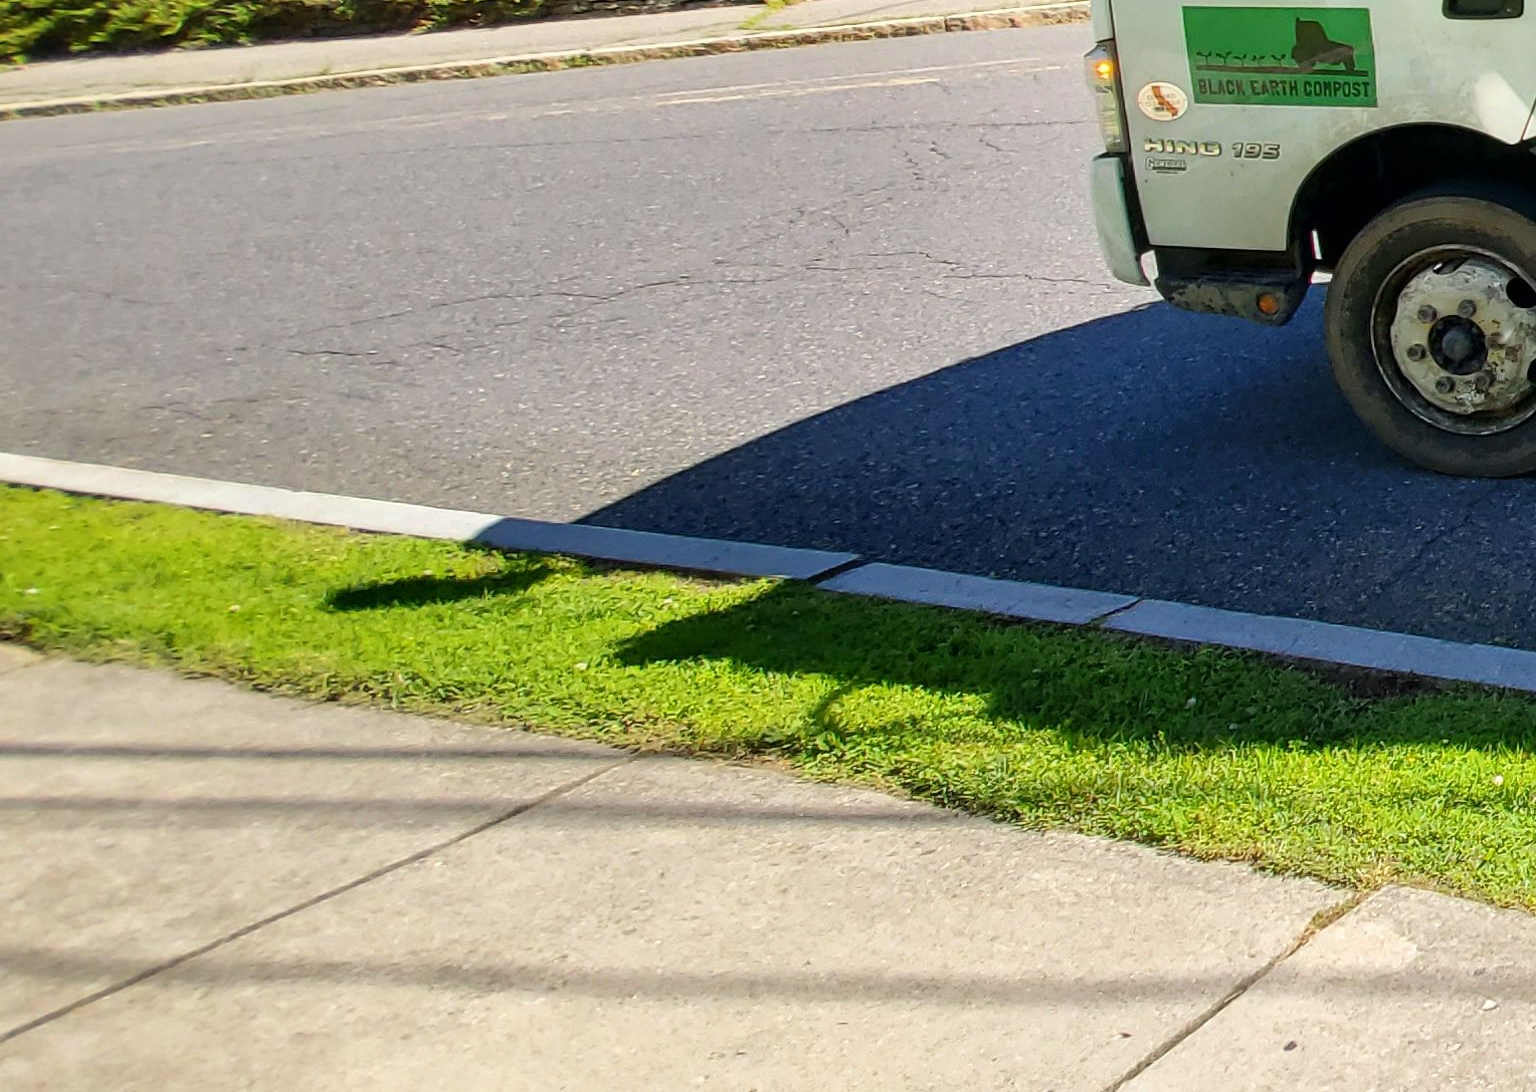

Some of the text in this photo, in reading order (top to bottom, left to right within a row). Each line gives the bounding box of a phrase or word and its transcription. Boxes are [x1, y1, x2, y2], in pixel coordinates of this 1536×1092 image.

[1198, 78, 1371, 99] BLACK EARTH COMPOST
[1143, 137, 1281, 160] HINO 195
